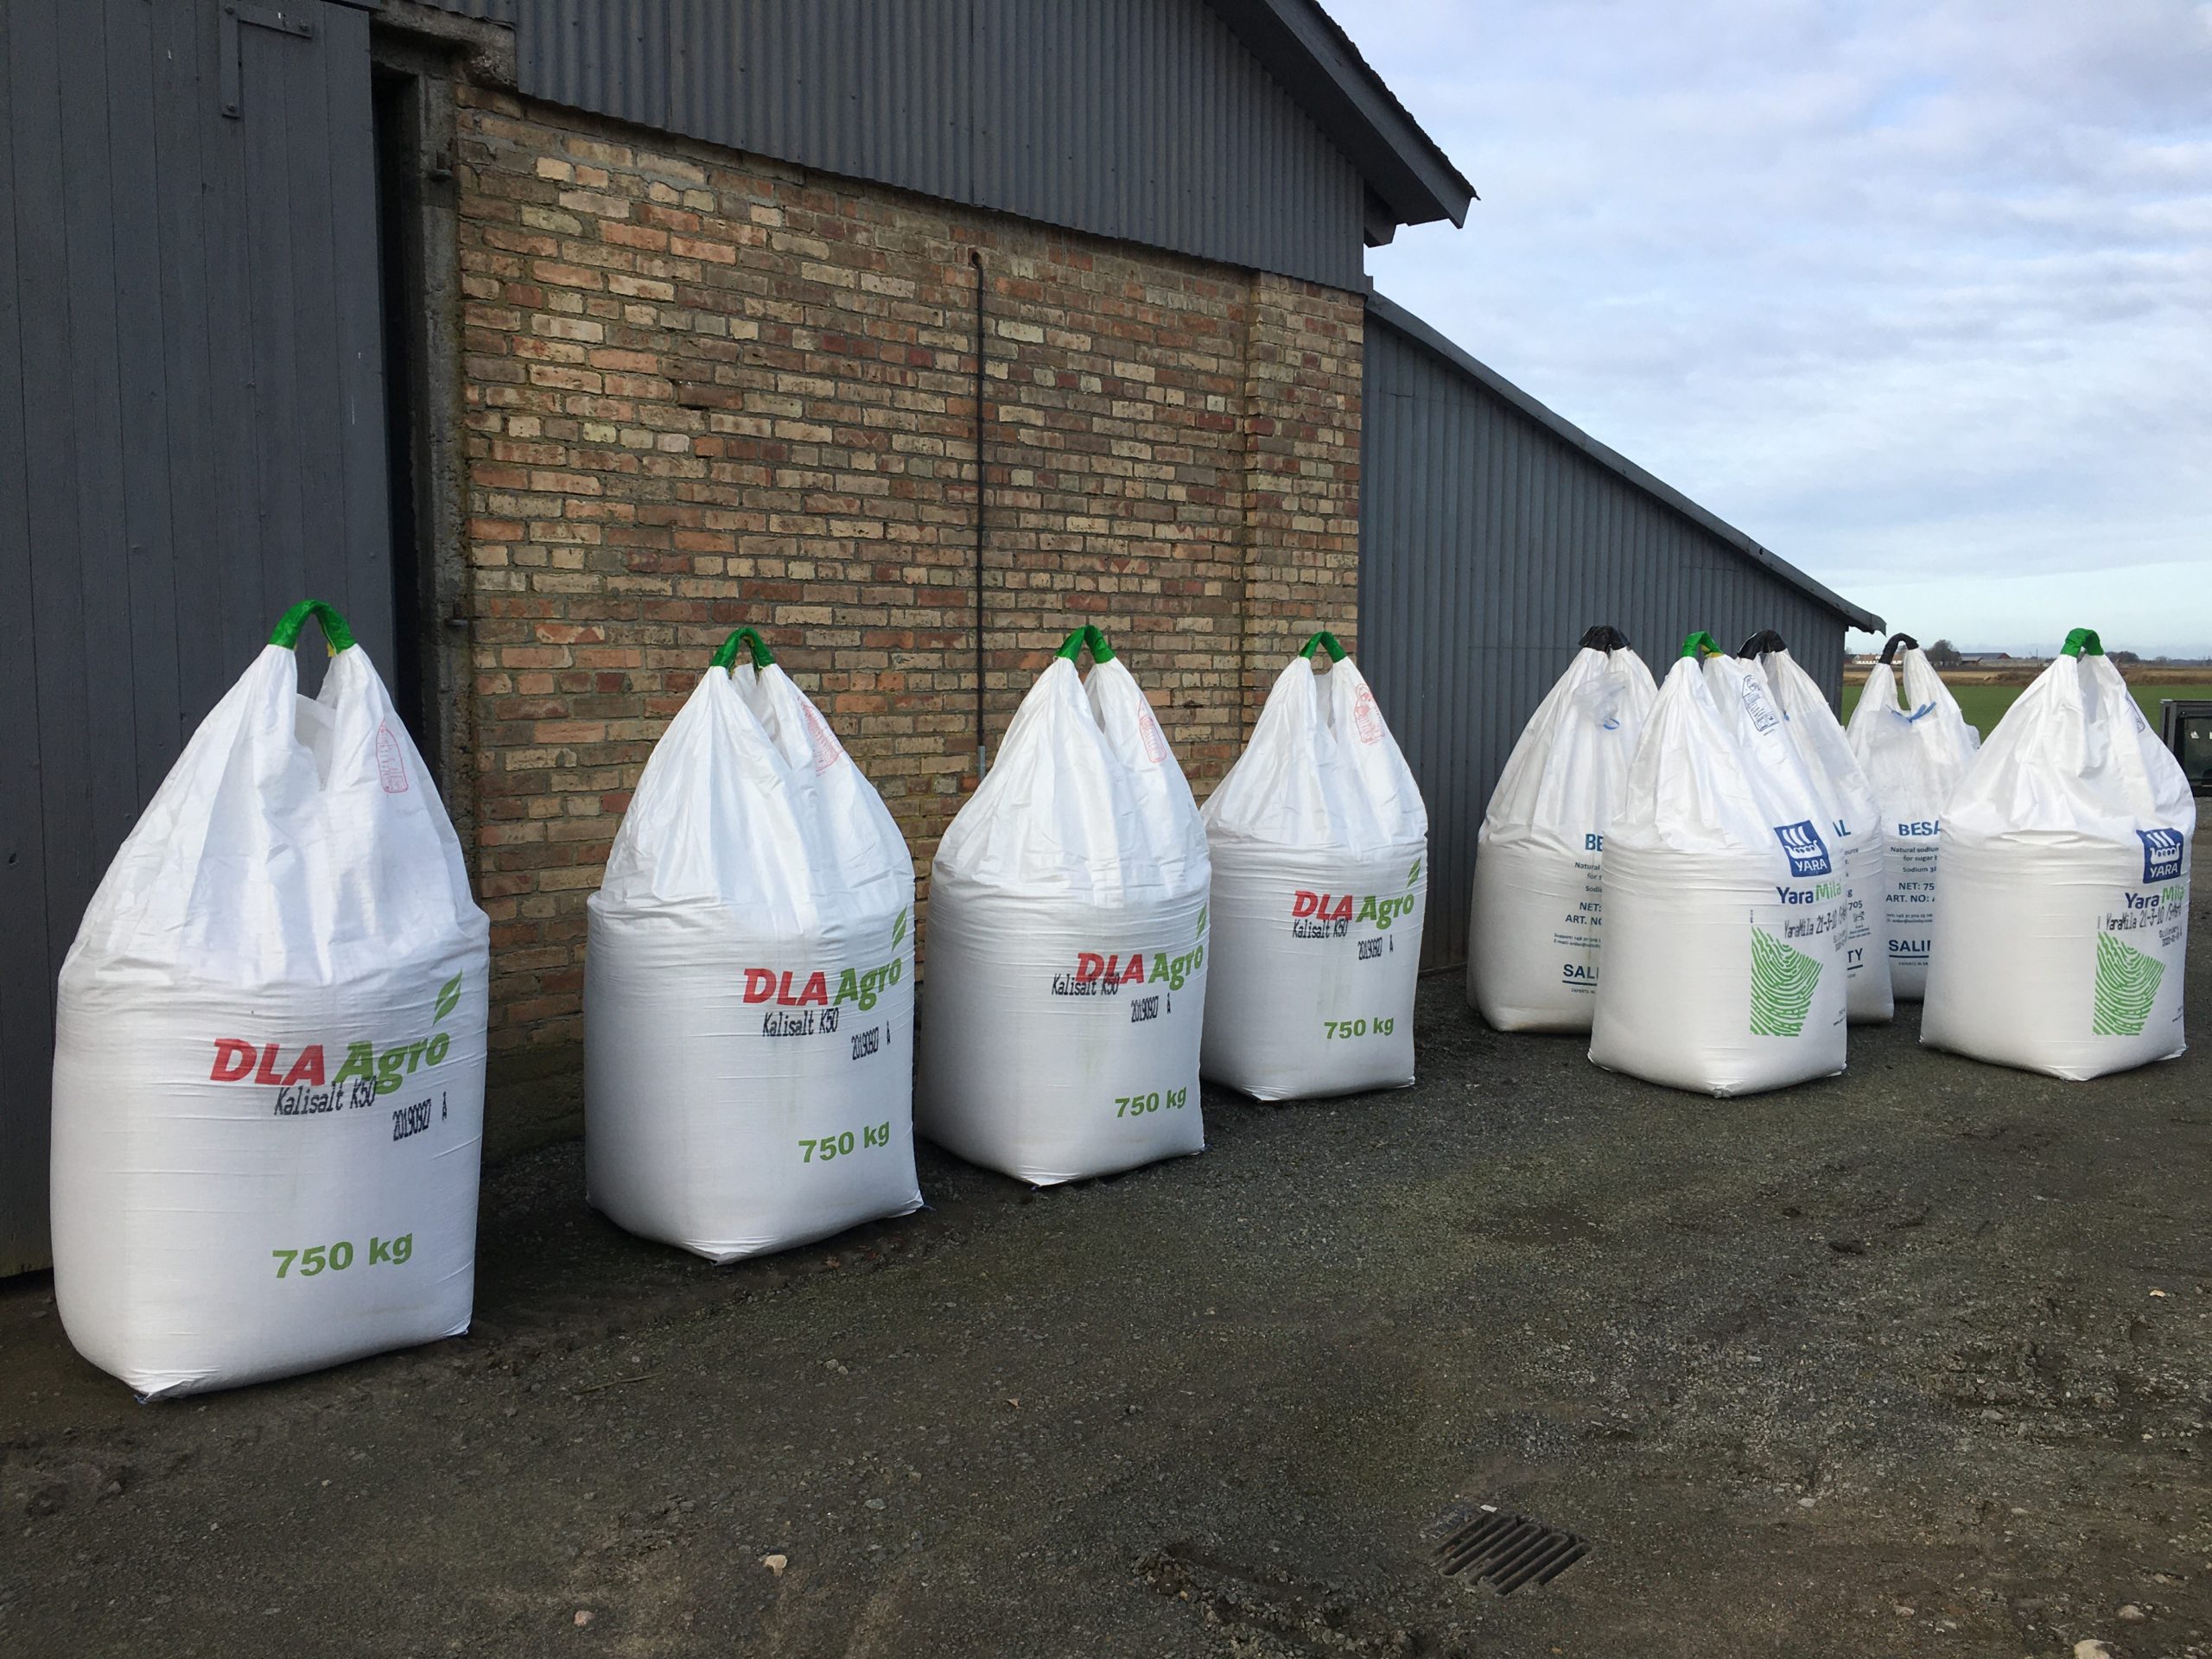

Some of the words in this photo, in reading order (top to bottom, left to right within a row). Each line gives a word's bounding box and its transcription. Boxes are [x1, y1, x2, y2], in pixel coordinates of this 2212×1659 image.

[1574, 861, 1600, 871] Natural
[1795, 858, 1827, 872] YARA
[2150, 863, 2178, 878] YARA
[1885, 894, 1907, 903] ART.
[1910, 894, 1929, 903] NO:
[1898, 882, 1920, 891] NET:
[1291, 890, 1353, 921] DLA
[1355, 893, 1414, 930] Agro
[1565, 914, 1587, 925] ART.
[1580, 901, 1602, 912] NET:
[1292, 918, 1330, 938] Kalisalt
[1332, 918, 1349, 938] K50
[1075, 952, 1144, 985] DLA
[1147, 945, 1204, 991] Agro
[742, 968, 828, 1006] DLA
[832, 957, 902, 1011] Agro
[1051, 973, 1096, 995] Kalisalt
[1101, 972, 1120, 995] K50
[762, 1009, 814, 1037] Kalisalt
[818, 1007, 839, 1033] K50
[1324, 1019, 1366, 1039] 750
[1373, 1017, 1394, 1036] kg
[209, 1038, 326, 1086] DLA
[333, 1032, 450, 1096] Agro
[274, 1081, 344, 1116] Kalisalt
[349, 1075, 378, 1110] K50
[1115, 1092, 1160, 1118] 750
[1166, 1086, 1186, 1109] kg
[392, 1098, 432, 1141] 20190927
[798, 1131, 855, 1163] 750
[864, 1121, 889, 1148] kg
[271, 1240, 353, 1278] 750
[368, 1232, 413, 1265] kg
